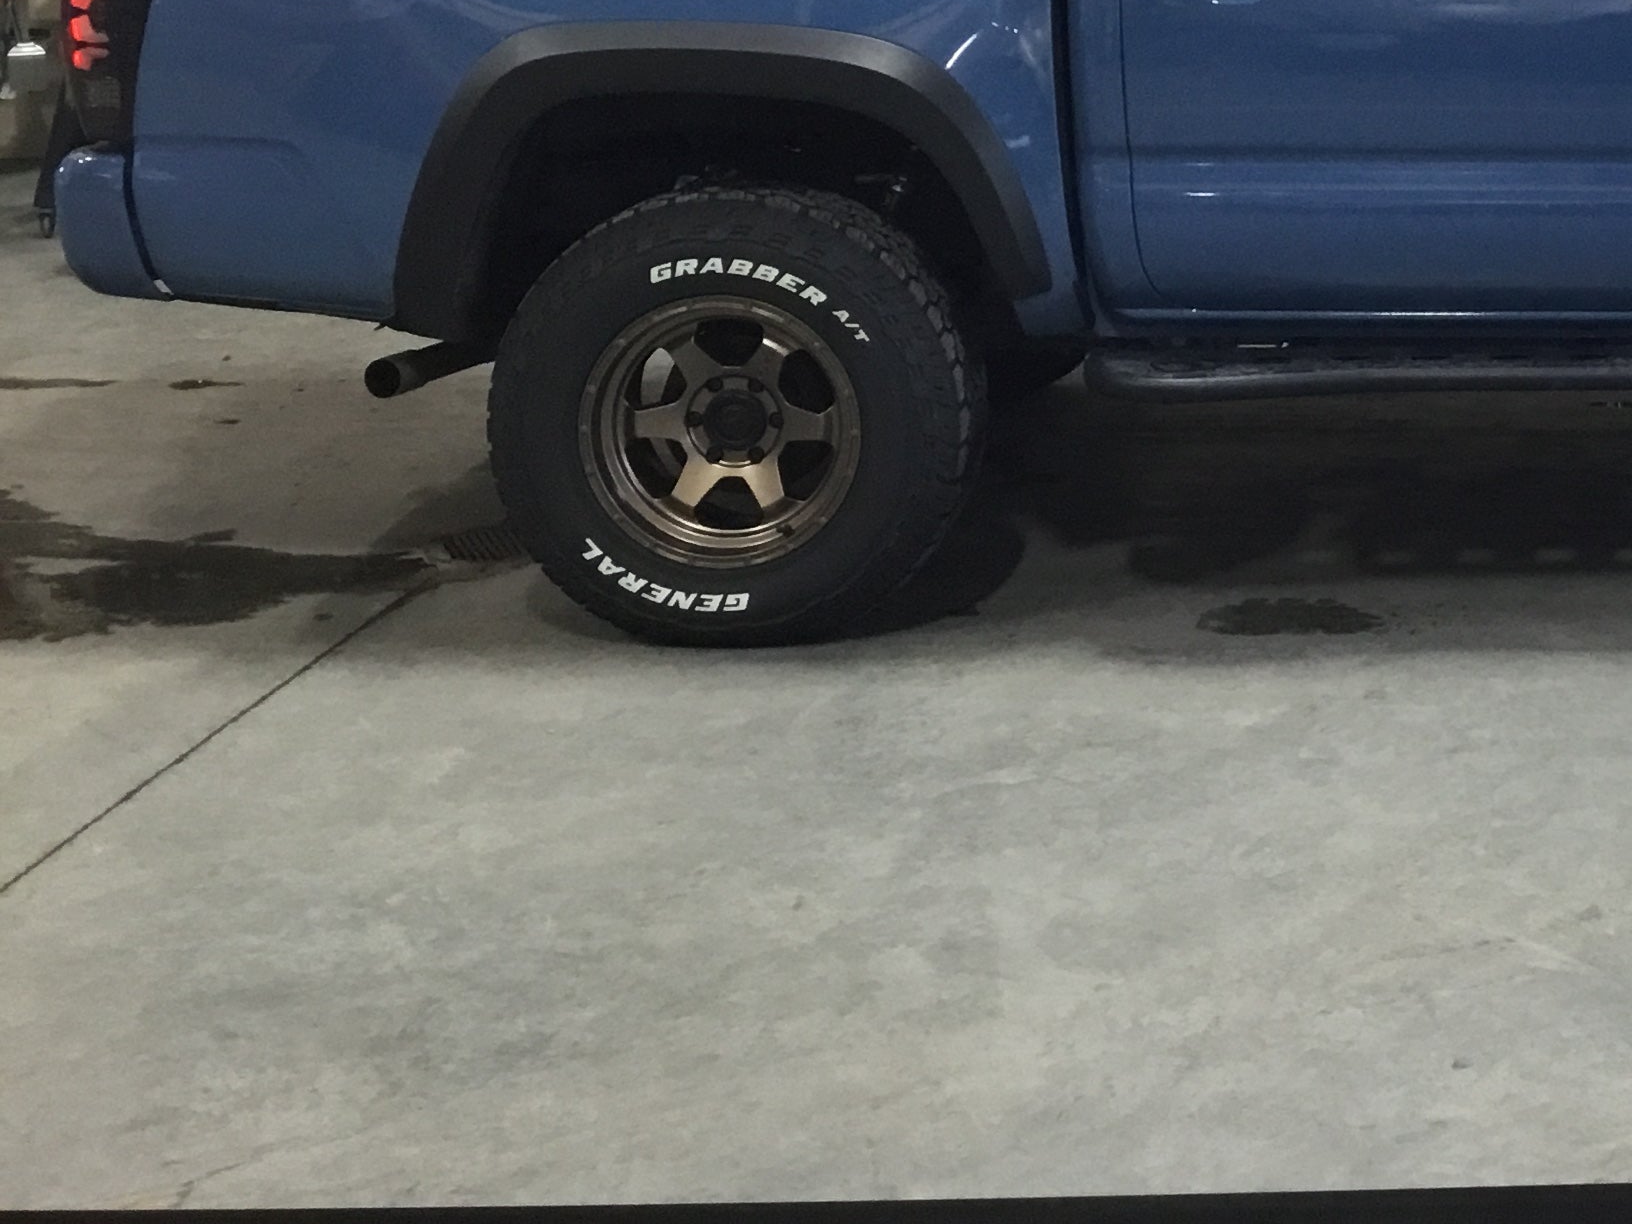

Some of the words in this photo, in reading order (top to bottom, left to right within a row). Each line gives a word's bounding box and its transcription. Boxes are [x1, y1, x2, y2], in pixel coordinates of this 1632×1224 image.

[649, 257, 828, 307] GRABBER
[832, 310, 871, 344] A/T
[580, 537, 751, 613] GENERAL
